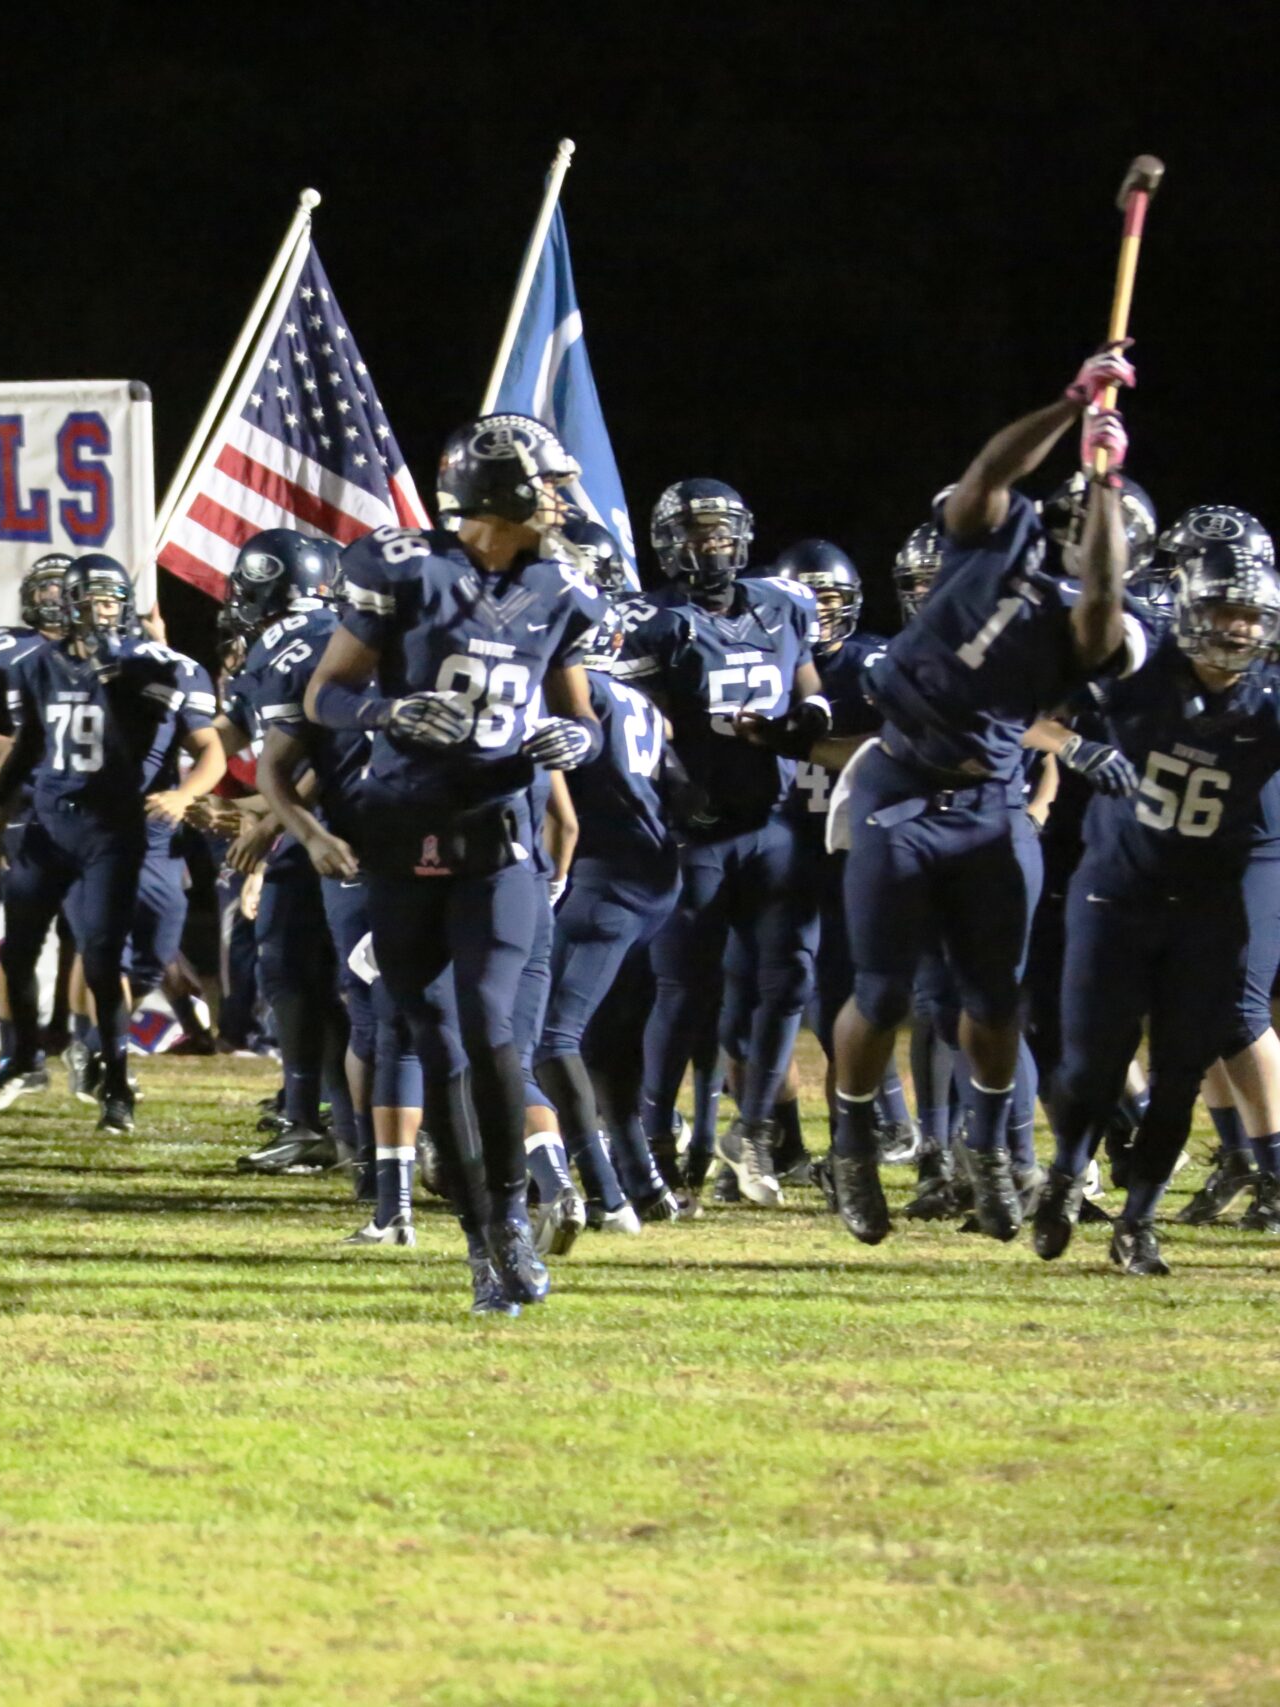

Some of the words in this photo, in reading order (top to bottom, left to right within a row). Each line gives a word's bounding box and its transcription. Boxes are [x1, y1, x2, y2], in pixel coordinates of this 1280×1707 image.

[955, 597, 1024, 670] 1
[46, 703, 105, 772] 79
[435, 653, 531, 748] 88
[1135, 750, 1231, 838] 56
